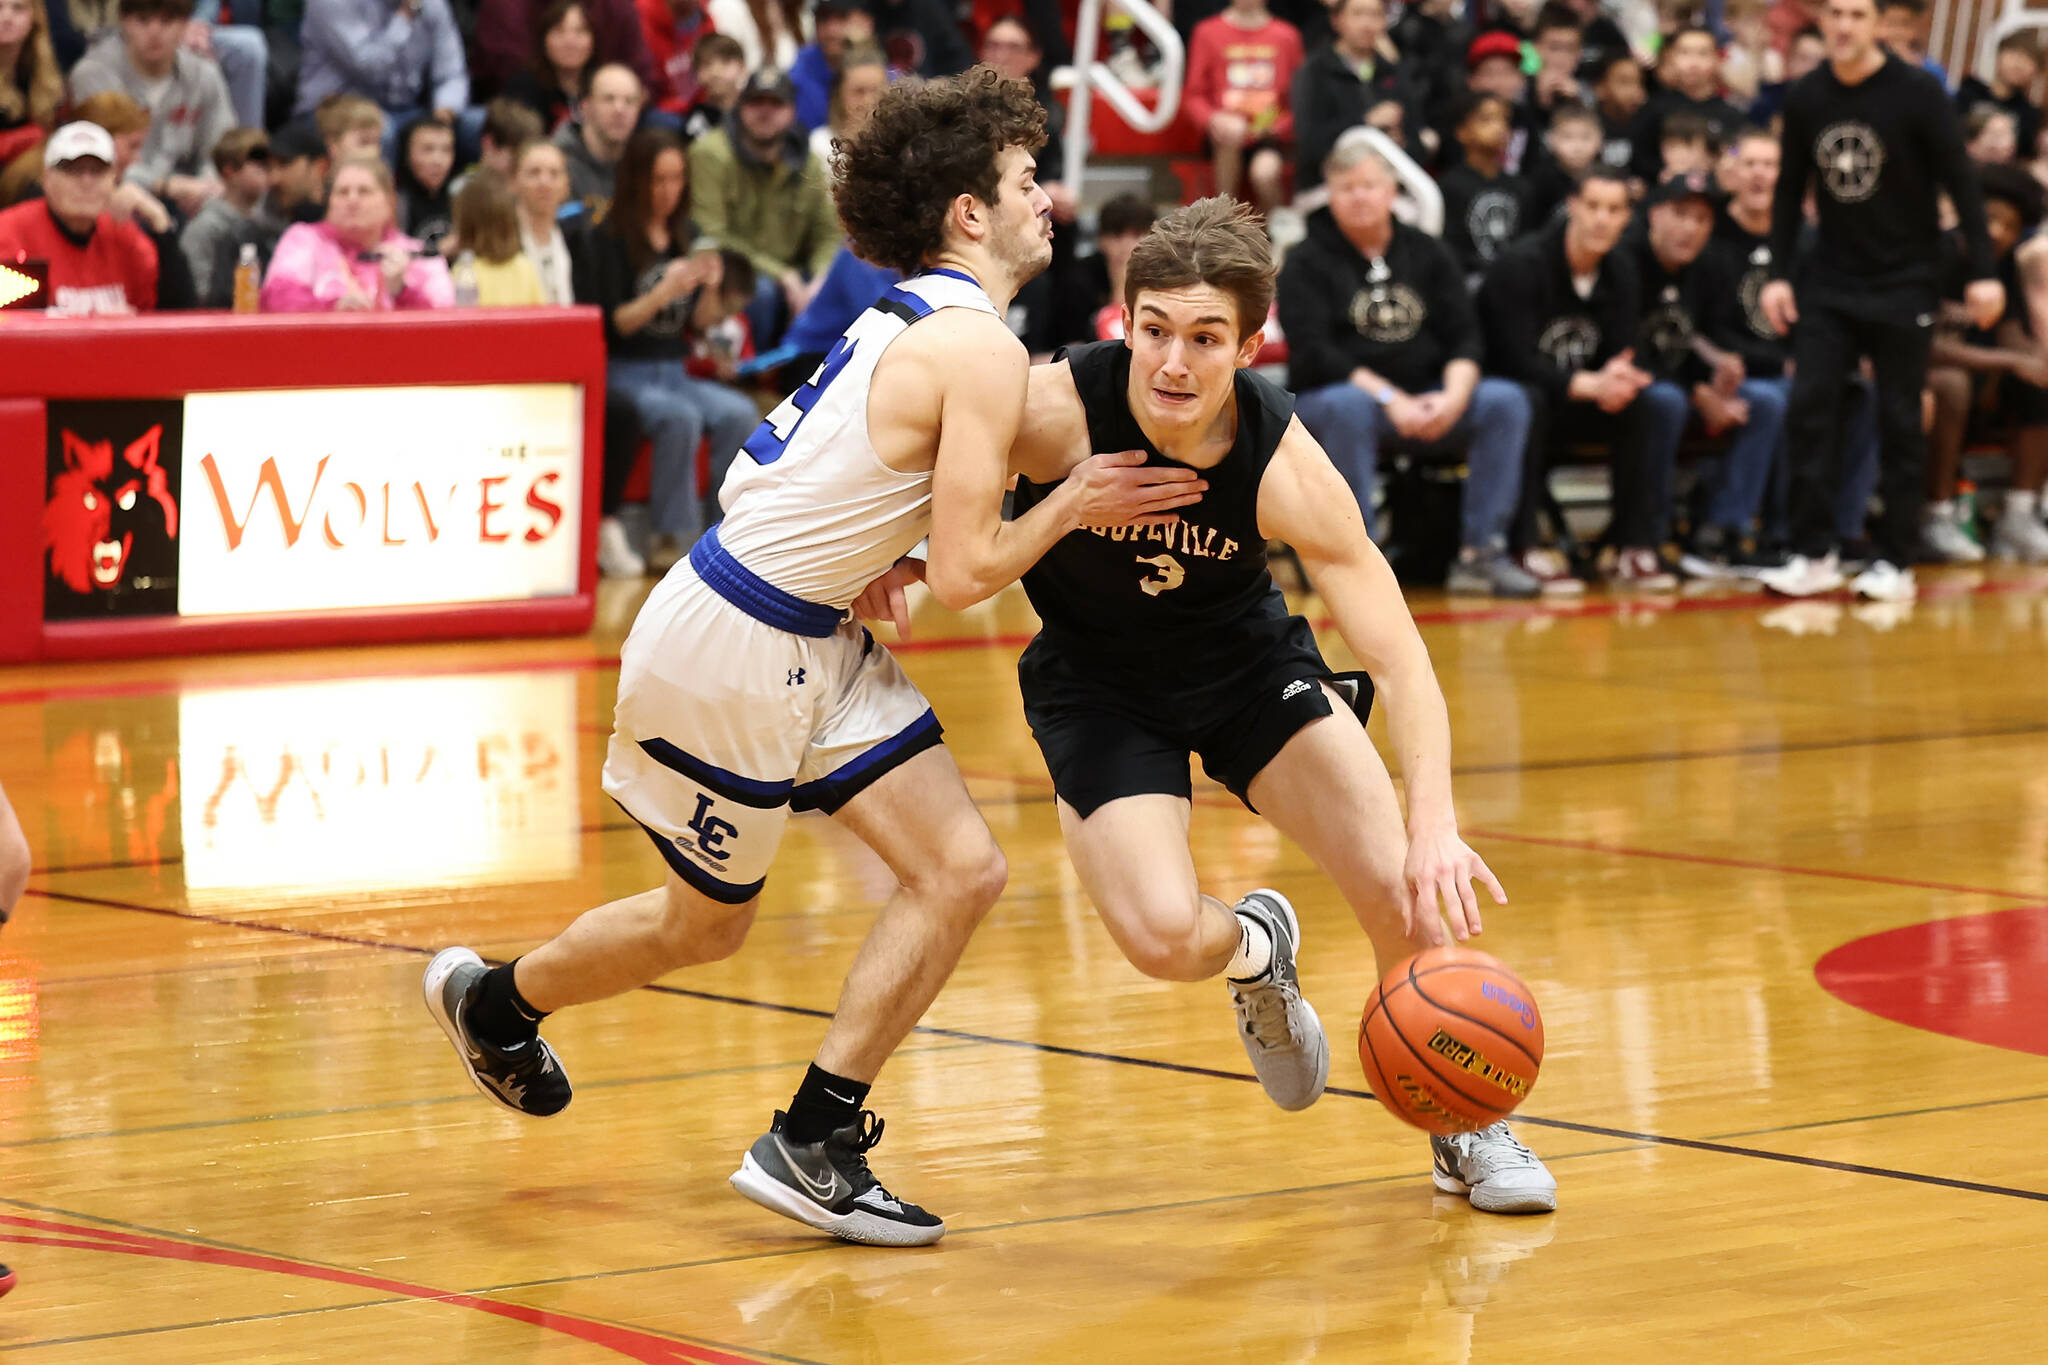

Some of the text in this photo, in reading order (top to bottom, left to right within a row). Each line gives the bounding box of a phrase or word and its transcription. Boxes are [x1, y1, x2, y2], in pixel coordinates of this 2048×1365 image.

[1136, 554, 1185, 596] 3
[1282, 683, 1311, 700] adidas
[1429, 1029, 1474, 1070] PRO
